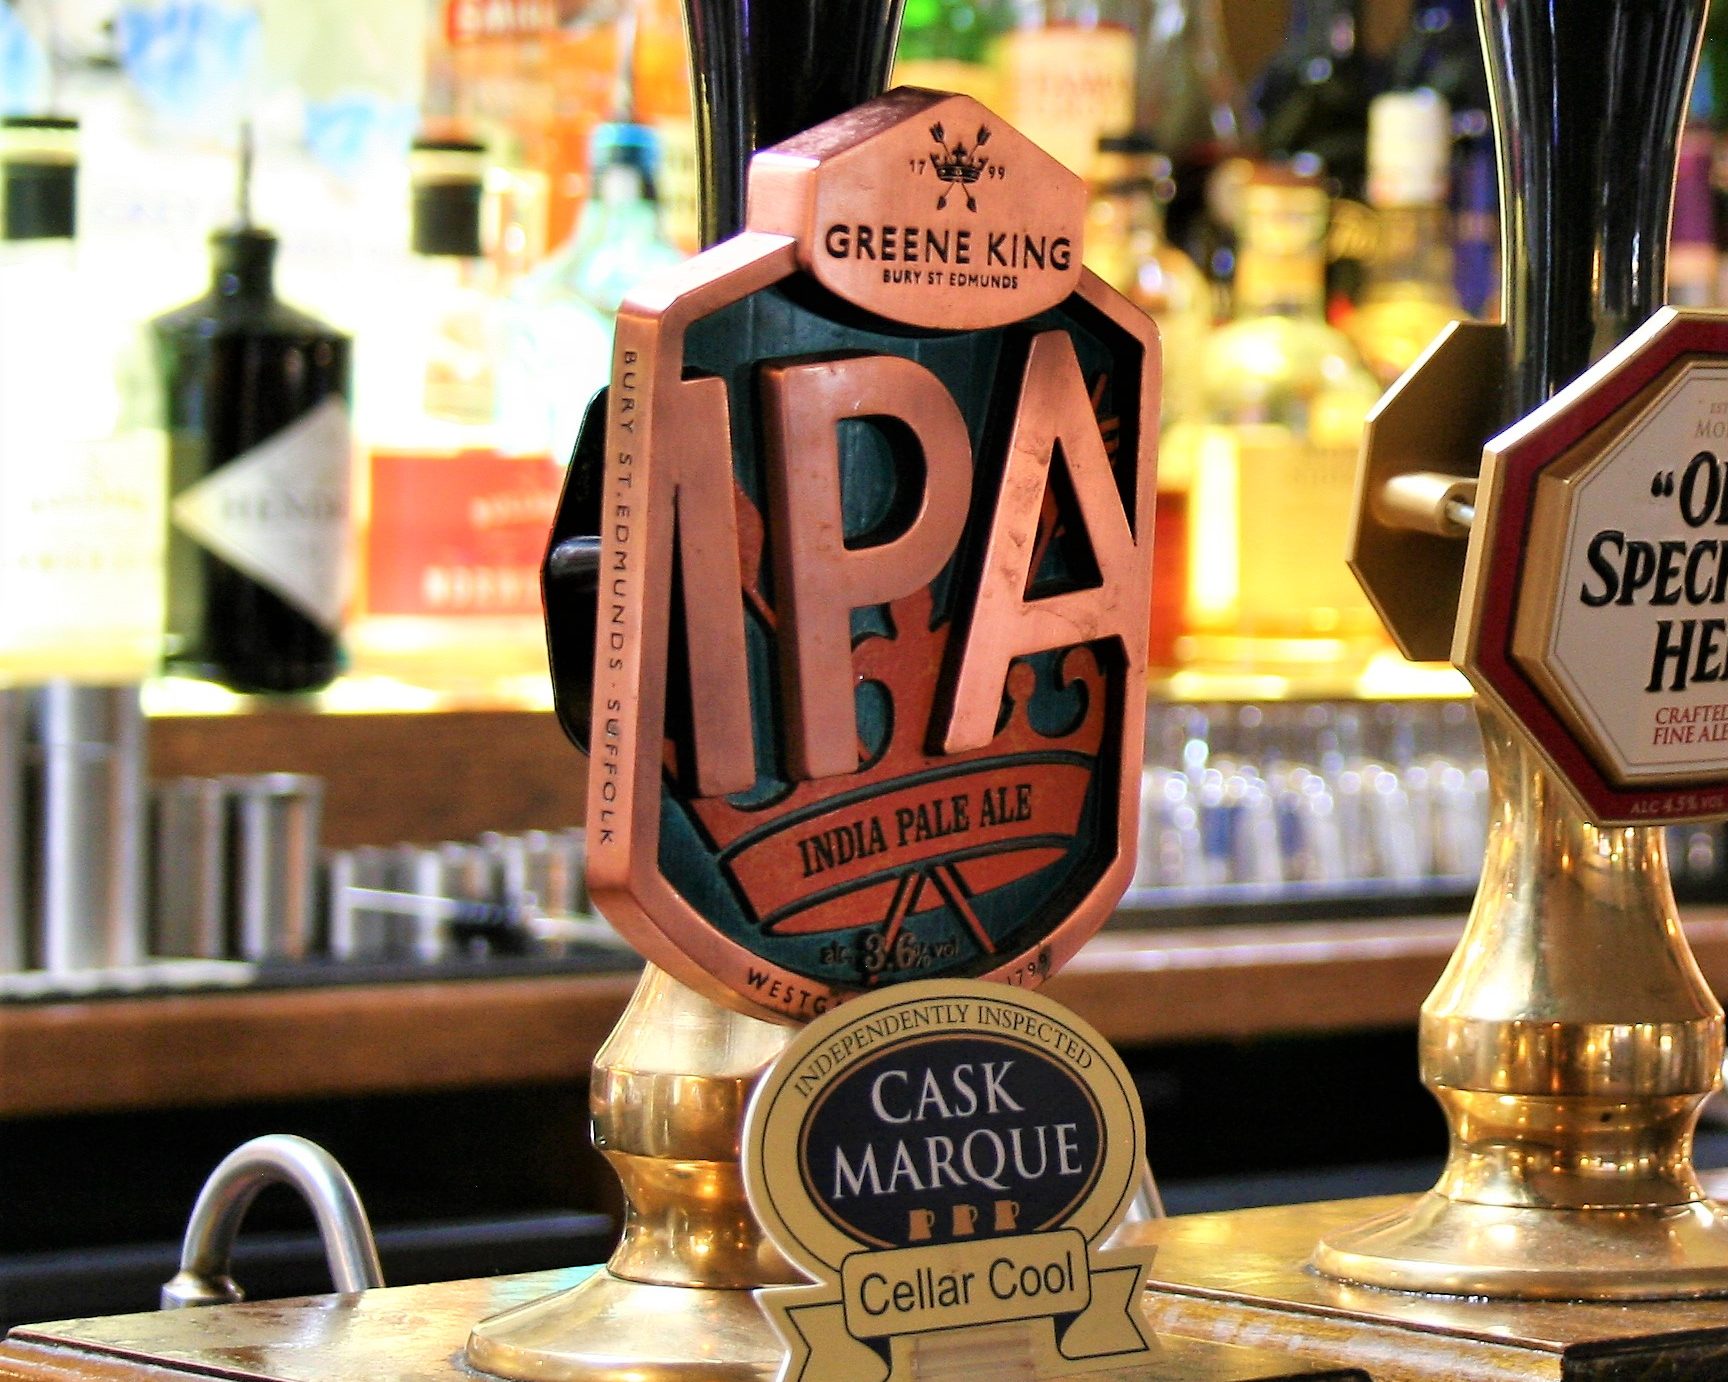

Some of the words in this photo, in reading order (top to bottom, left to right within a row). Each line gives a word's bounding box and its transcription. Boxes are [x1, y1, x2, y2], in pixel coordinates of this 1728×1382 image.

[825, 224, 971, 264] GREENE
[987, 233, 1072, 271] KING
[883, 269, 921, 285] BURY
[928, 271, 943, 285] ST
[949, 272, 1018, 289] EDMUNDS
[620, 351, 637, 432] BURY
[675, 328, 1145, 797] IPA
[1653, 720, 1696, 745] FINE
[600, 699, 621, 844] SUFFOLK
[798, 816, 887, 877] INDIA
[896, 801, 970, 846] PALE
[979, 784, 1032, 824] ALE
[746, 967, 844, 1015] WESTG
[795, 1003, 970, 1098] INDEPENDENTLY
[977, 1005, 1093, 1070] INSPECTED
[871, 1060, 1025, 1124] CASK
[832, 1122, 1083, 1199] MARQUE
[860, 1267, 975, 1316] Cellar
[988, 1251, 1075, 1300] Cool
